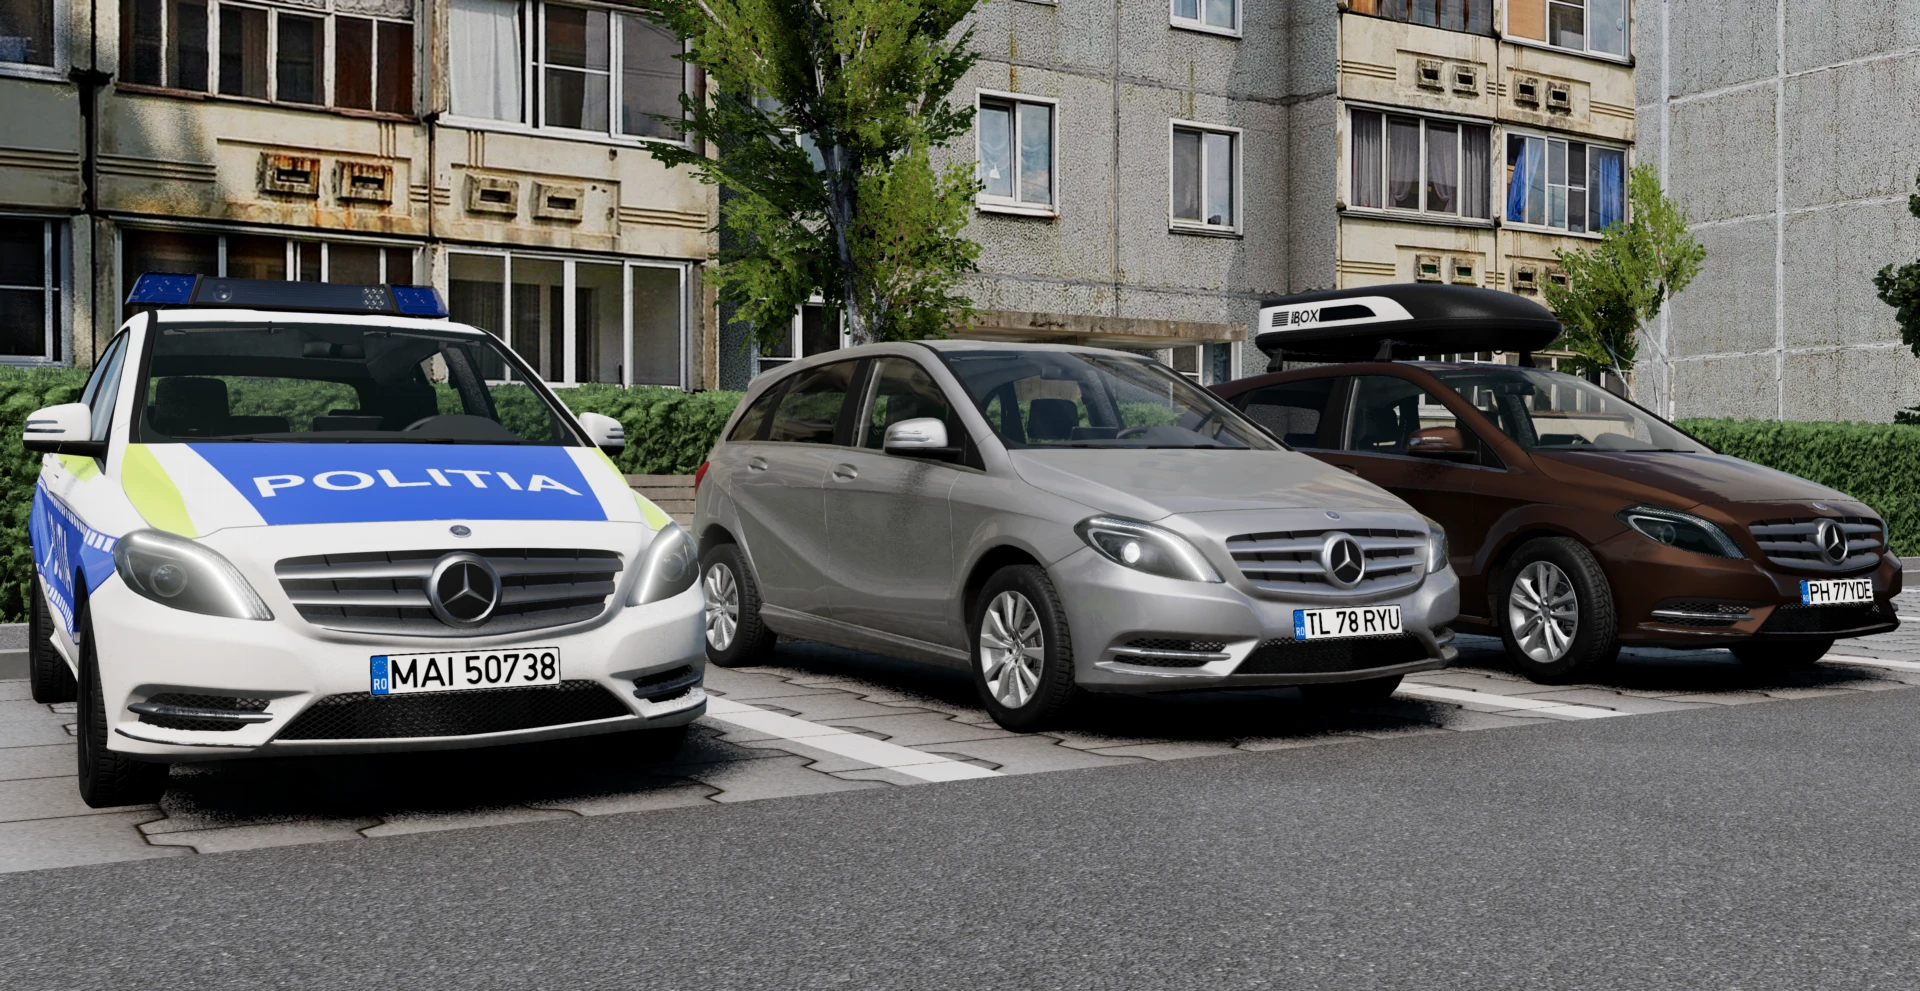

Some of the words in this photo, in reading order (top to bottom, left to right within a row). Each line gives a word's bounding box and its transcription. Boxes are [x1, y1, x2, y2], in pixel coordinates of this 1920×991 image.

[253, 468, 583, 498] POLITIA
[1809, 583, 1831, 602] PH
[1306, 612, 1331, 635] TL
[1336, 611, 1359, 634] 78
[1363, 608, 1400, 632] RYU
[373, 678, 387, 690] RO
[391, 656, 454, 689] MAI
[465, 652, 556, 685] 50738
